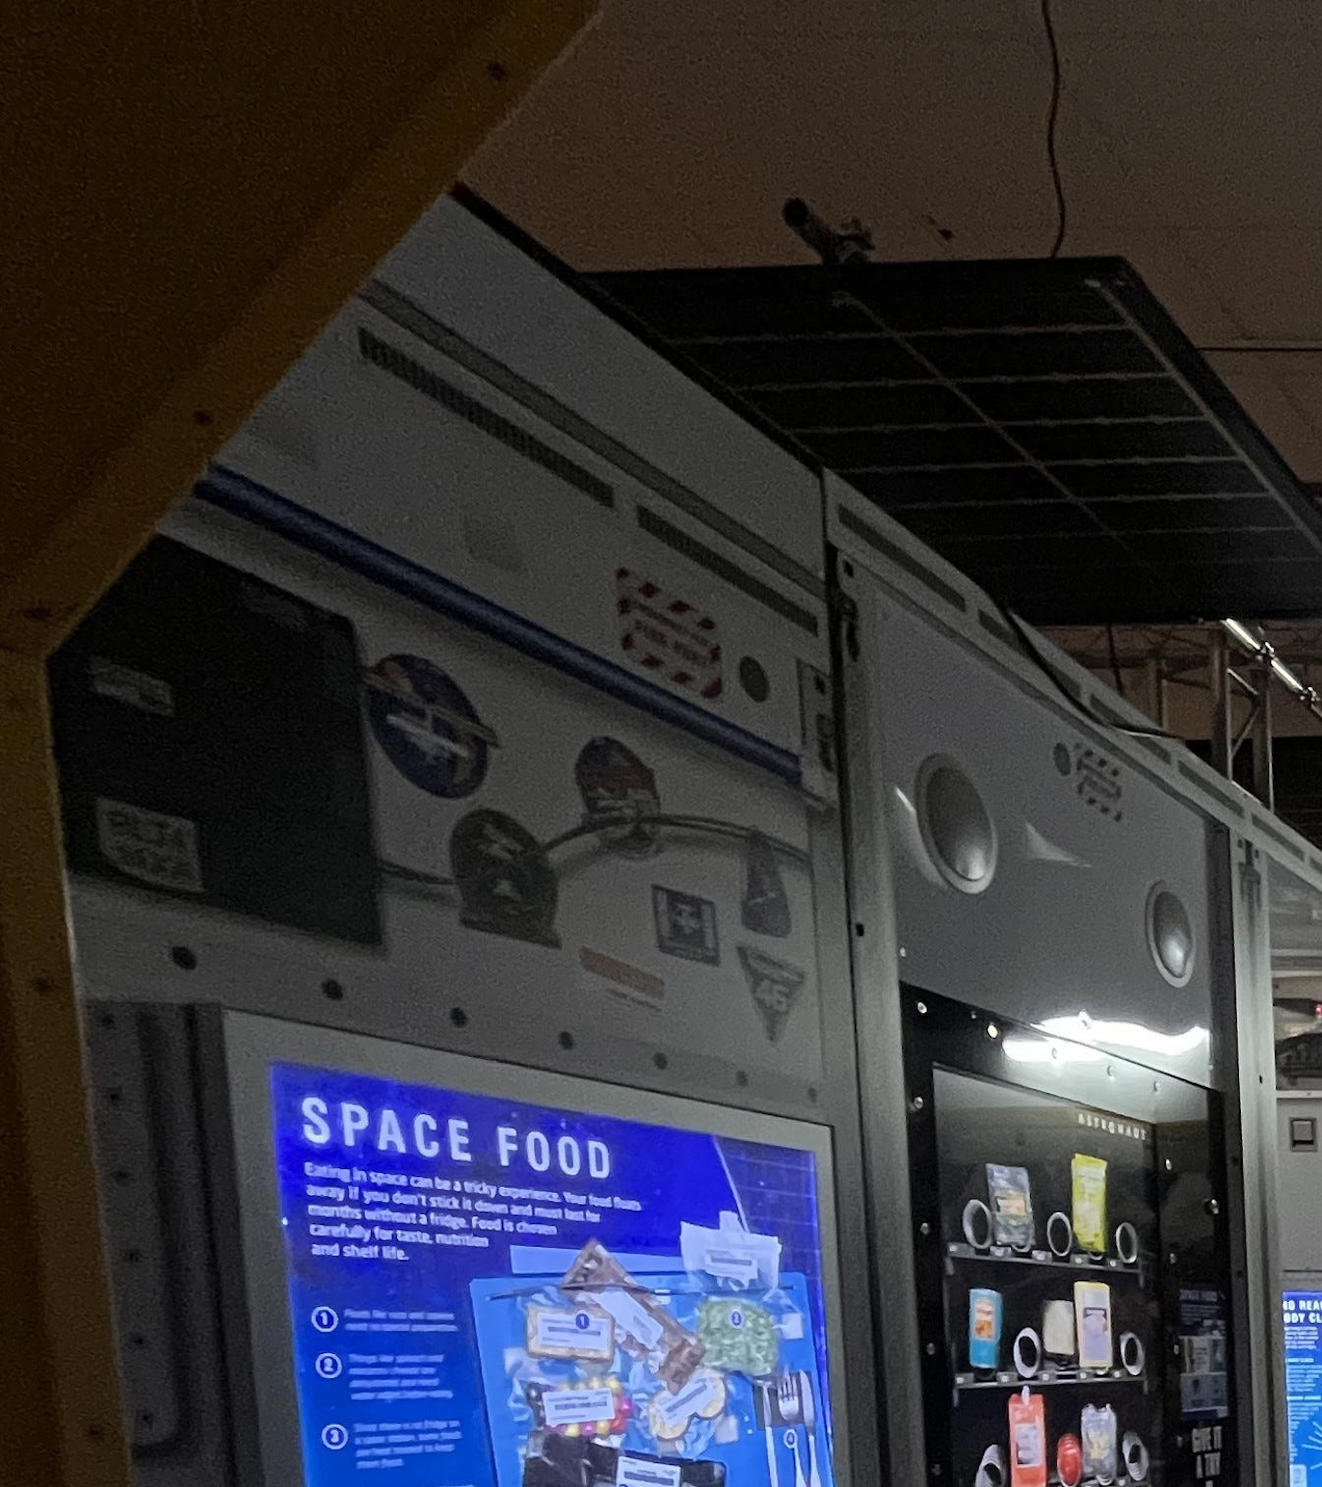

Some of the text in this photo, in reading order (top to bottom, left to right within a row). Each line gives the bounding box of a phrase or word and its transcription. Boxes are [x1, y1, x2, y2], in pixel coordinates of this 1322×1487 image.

[301, 1097, 611, 1179] SPACE FOOD
[305, 1162, 350, 1182] Eating
[353, 1166, 367, 1182] in
[369, 1171, 408, 1186] space
[410, 1176, 433, 1189] can
[435, 1177, 450, 1190] be
[453, 1181, 461, 1191] a
[464, 1181, 497, 1198] tricky
[306, 1184, 345, 1201] away
[348, 1185, 359, 1200] if
[362, 1190, 390, 1204] you
[392, 1190, 426, 1206] don't
[429, 1196, 460, 1209] stick
[462, 1197, 472, 1211] it
[475, 1200, 508, 1214] down
[510, 1204, 533, 1216] and
[534, 1207, 563, 1219] must
[308, 1205, 362, 1219] months
[364, 1208, 417, 1224] without
[419, 1213, 428, 1225] a
[429, 1212, 469, 1230] fridge.
[472, 1216, 501, 1231] Food
[503, 1219, 514, 1232] is
[310, 1223, 371, 1242] carefully
[374, 1226, 393, 1240] for
[312, 1243, 410, 1260] and shelf life.
